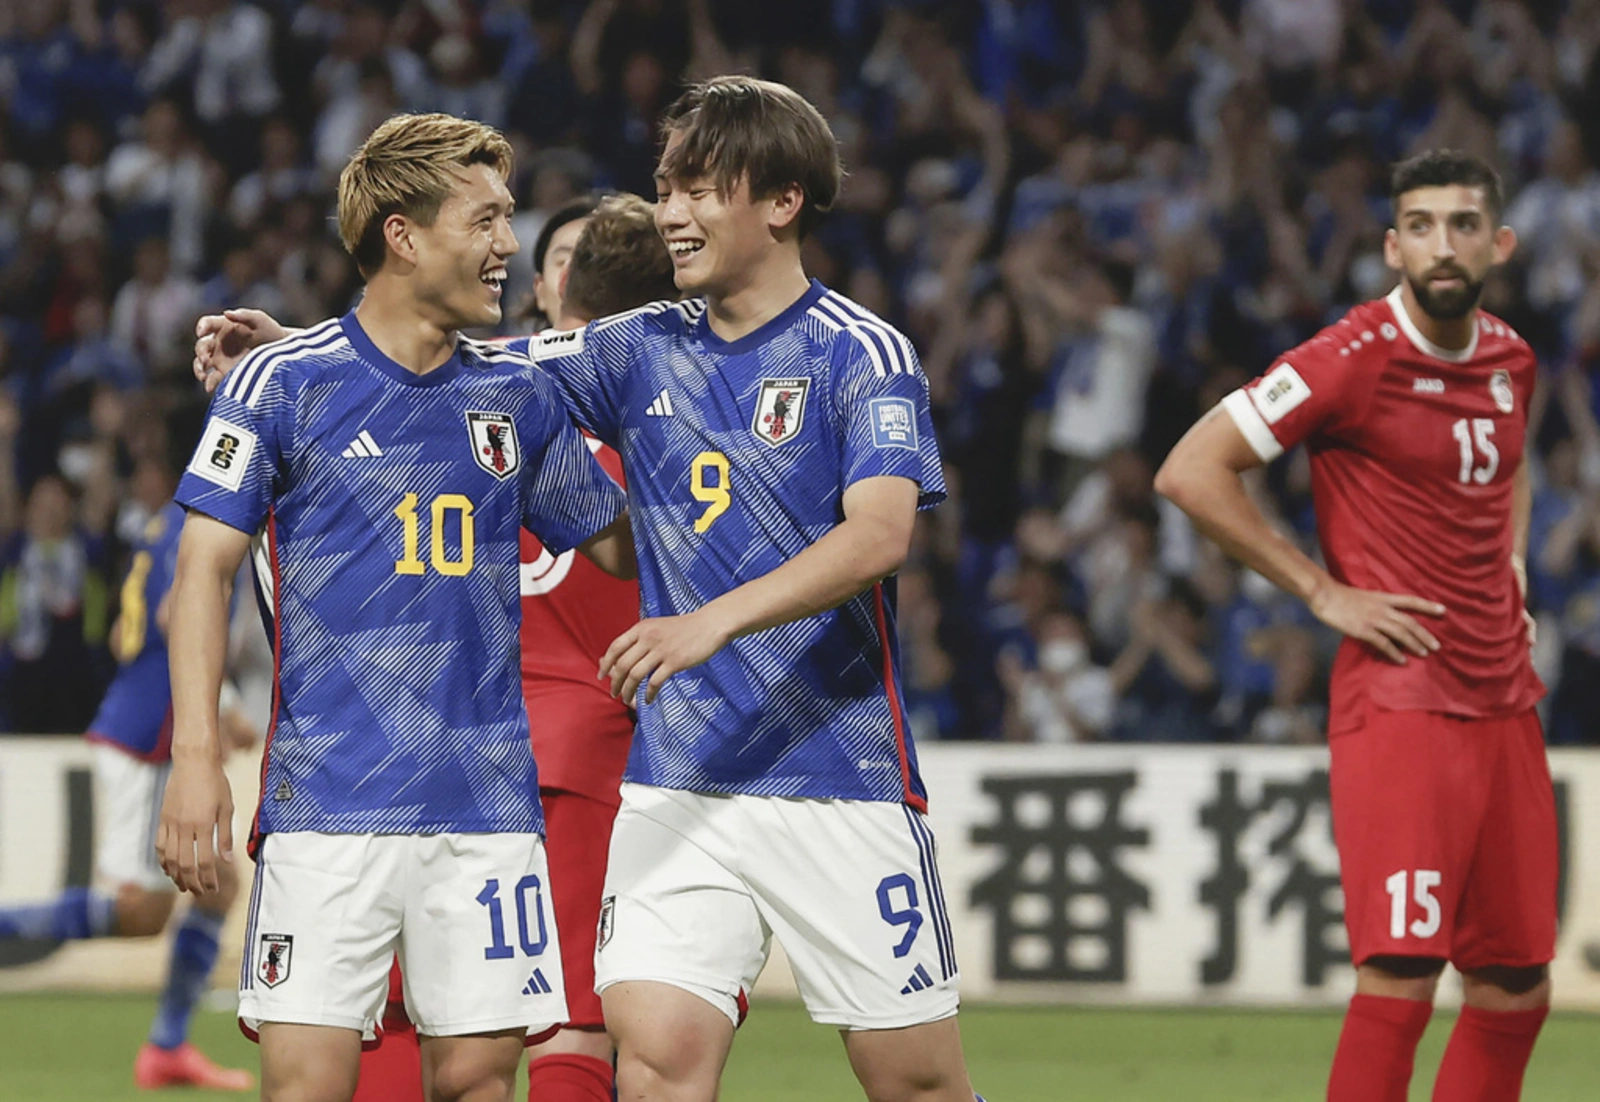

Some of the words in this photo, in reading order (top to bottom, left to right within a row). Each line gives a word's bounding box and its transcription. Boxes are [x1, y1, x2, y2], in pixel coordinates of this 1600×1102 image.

[690, 451, 731, 534] 9
[1452, 418, 1499, 485] 15
[394, 493, 475, 576] 10
[476, 874, 548, 960] 10
[876, 873, 923, 958] 9
[1385, 869, 1442, 939] 15
